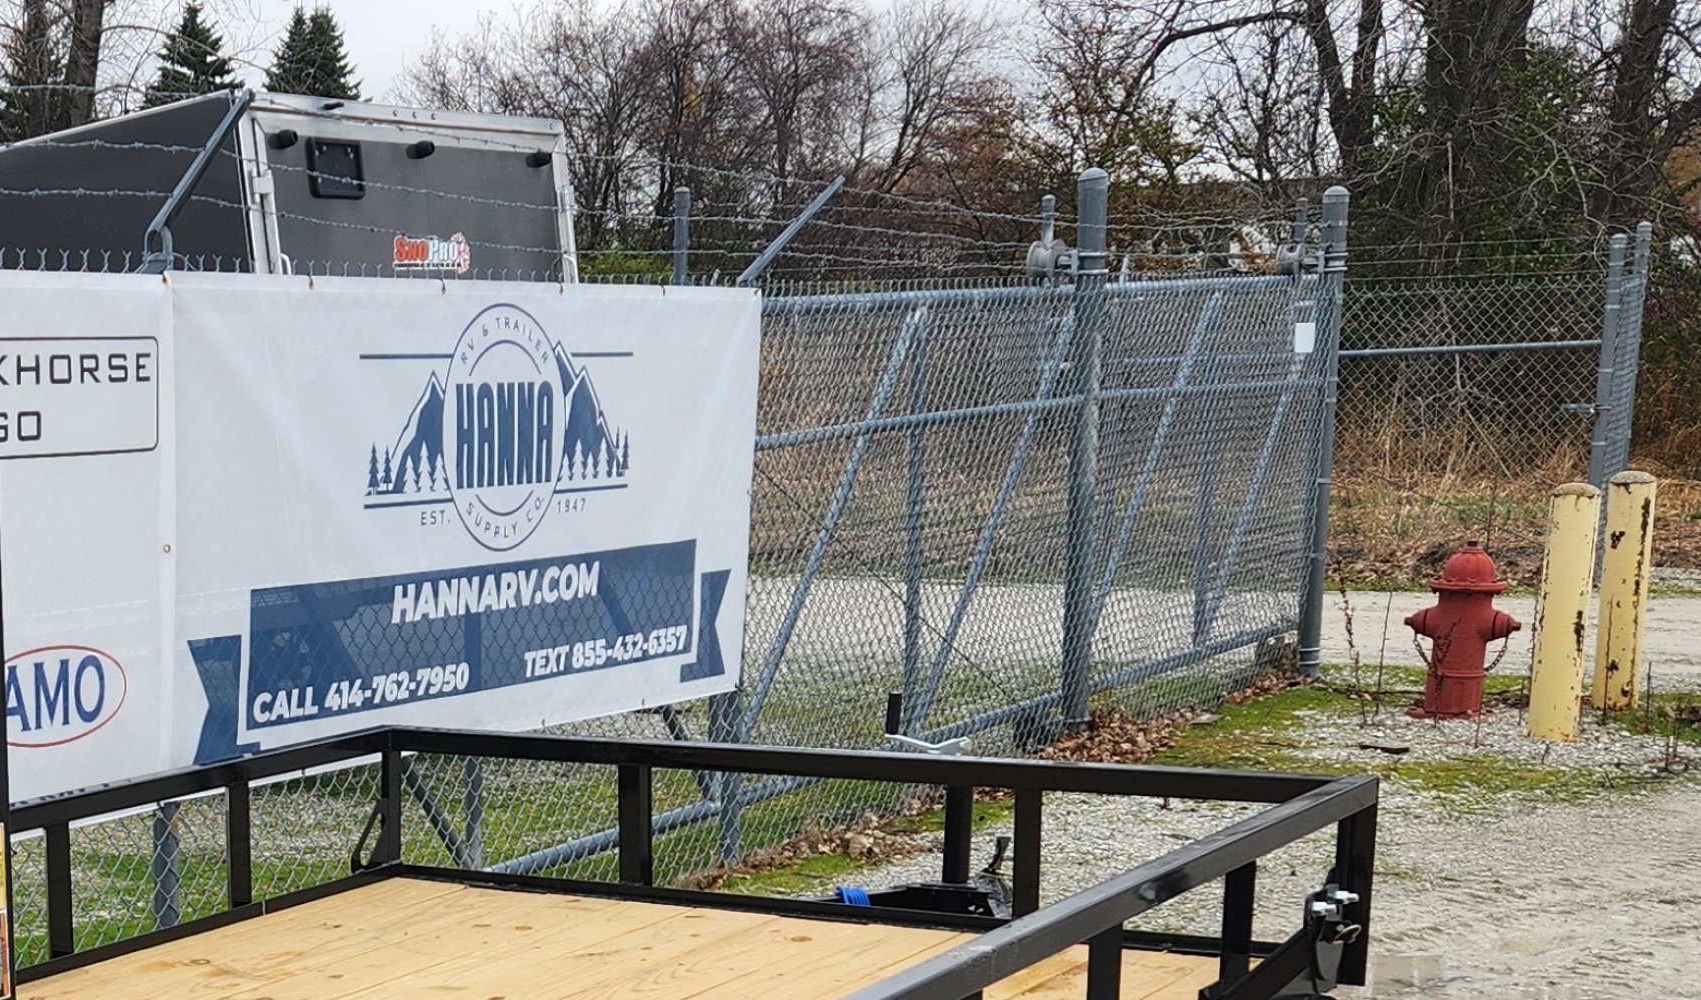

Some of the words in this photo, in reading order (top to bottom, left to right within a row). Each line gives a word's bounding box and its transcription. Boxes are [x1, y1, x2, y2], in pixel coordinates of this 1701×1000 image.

[460, 338, 474, 365] RV
[481, 324, 489, 337] &
[495, 316, 549, 364] TRAILER
[456, 381, 554, 490] HANNA
[420, 510, 451, 526] EST.
[556, 498, 587, 514] 1947
[466, 502, 519, 539] SUPPLY
[526, 496, 544, 523] CO.
[392, 561, 600, 625] HANNARV.COM
[524, 645, 570, 679] TEXT
[572, 625, 687, 670] 855-432-6357
[252, 686, 319, 724] CALL
[324, 662, 470, 711] 414-762-7950
